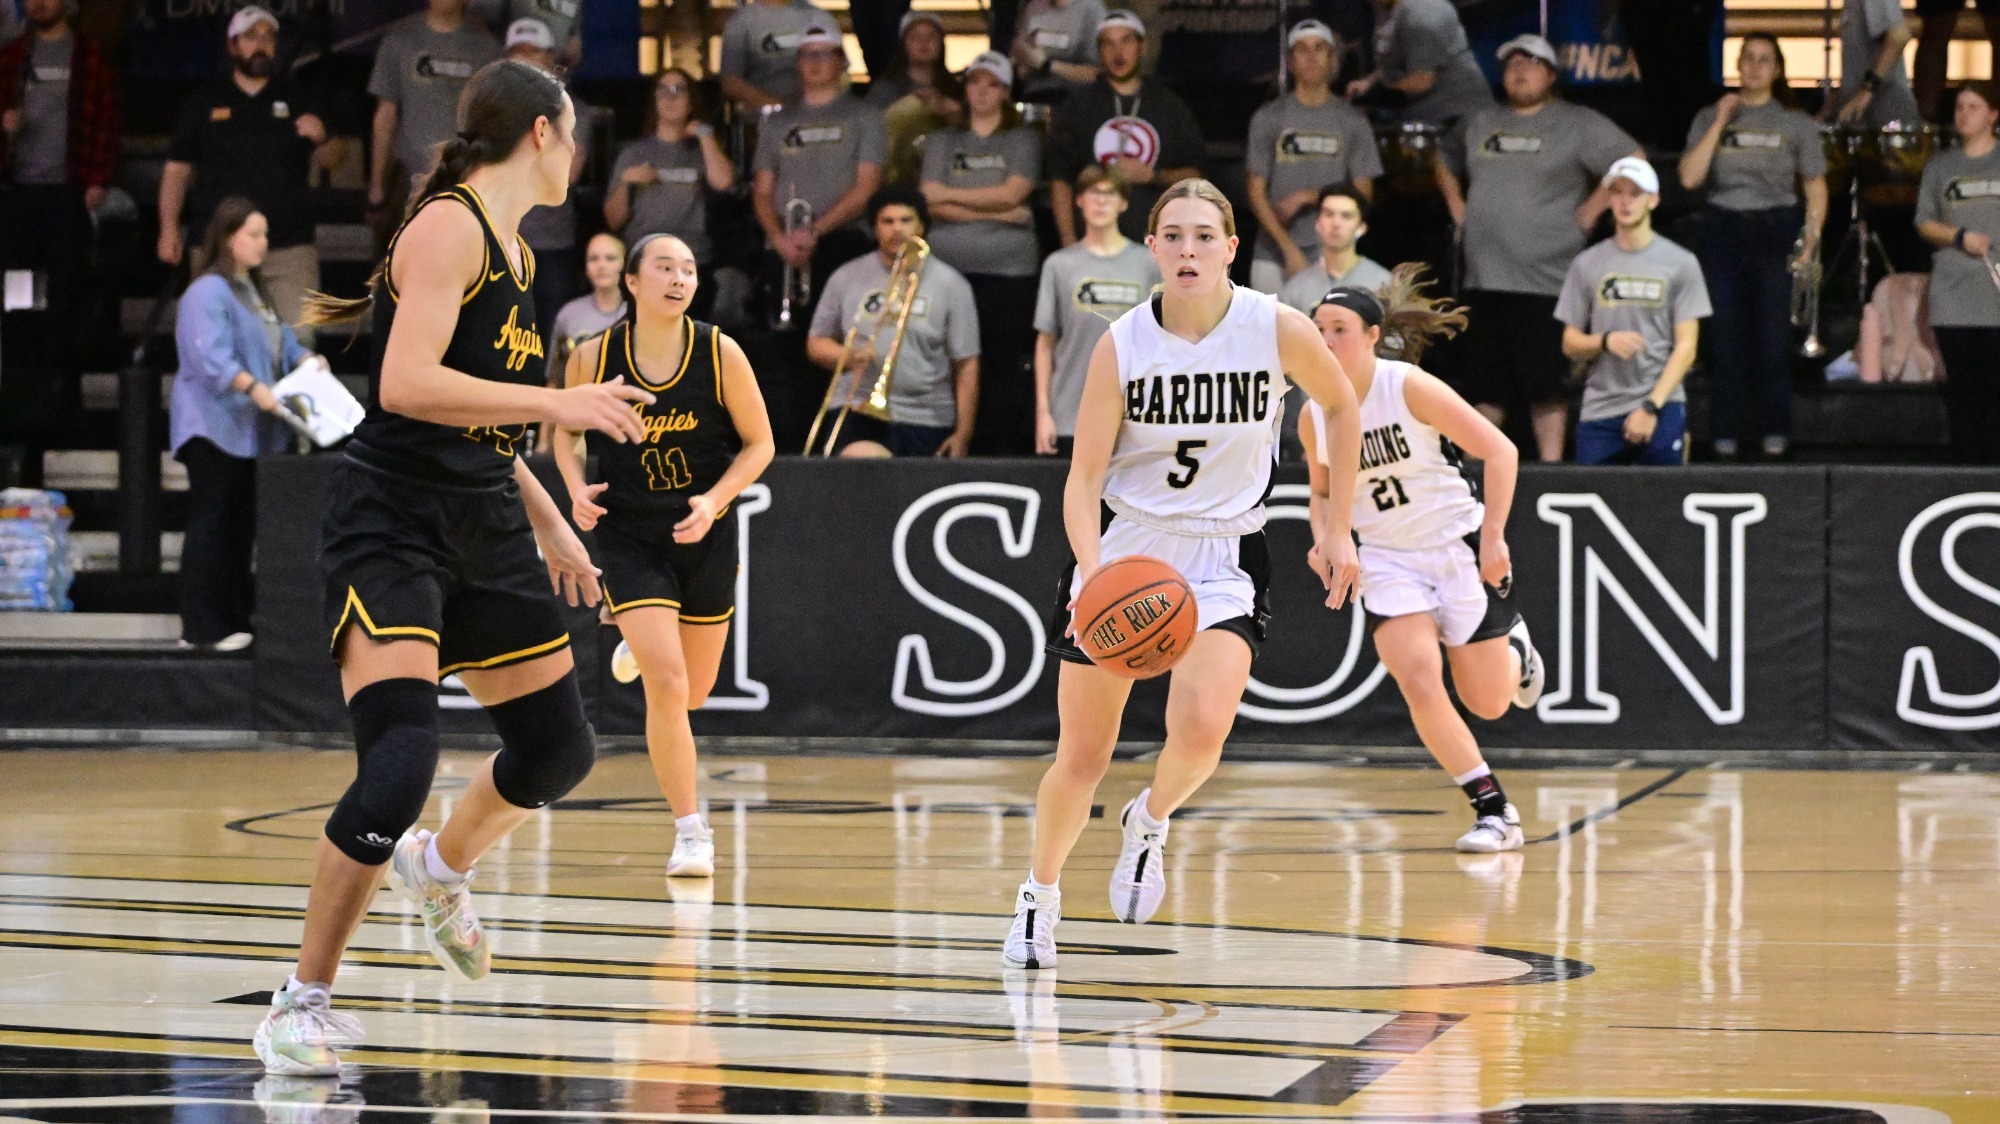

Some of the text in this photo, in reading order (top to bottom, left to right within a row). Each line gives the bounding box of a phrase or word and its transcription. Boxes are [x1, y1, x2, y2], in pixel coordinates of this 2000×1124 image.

[1127, 370, 1270, 424] HARDING
[641, 446, 692, 490] 11
[1167, 440, 1207, 489] 5
[1369, 475, 1410, 512] 21
[1090, 593, 1172, 650] THE ROCK
